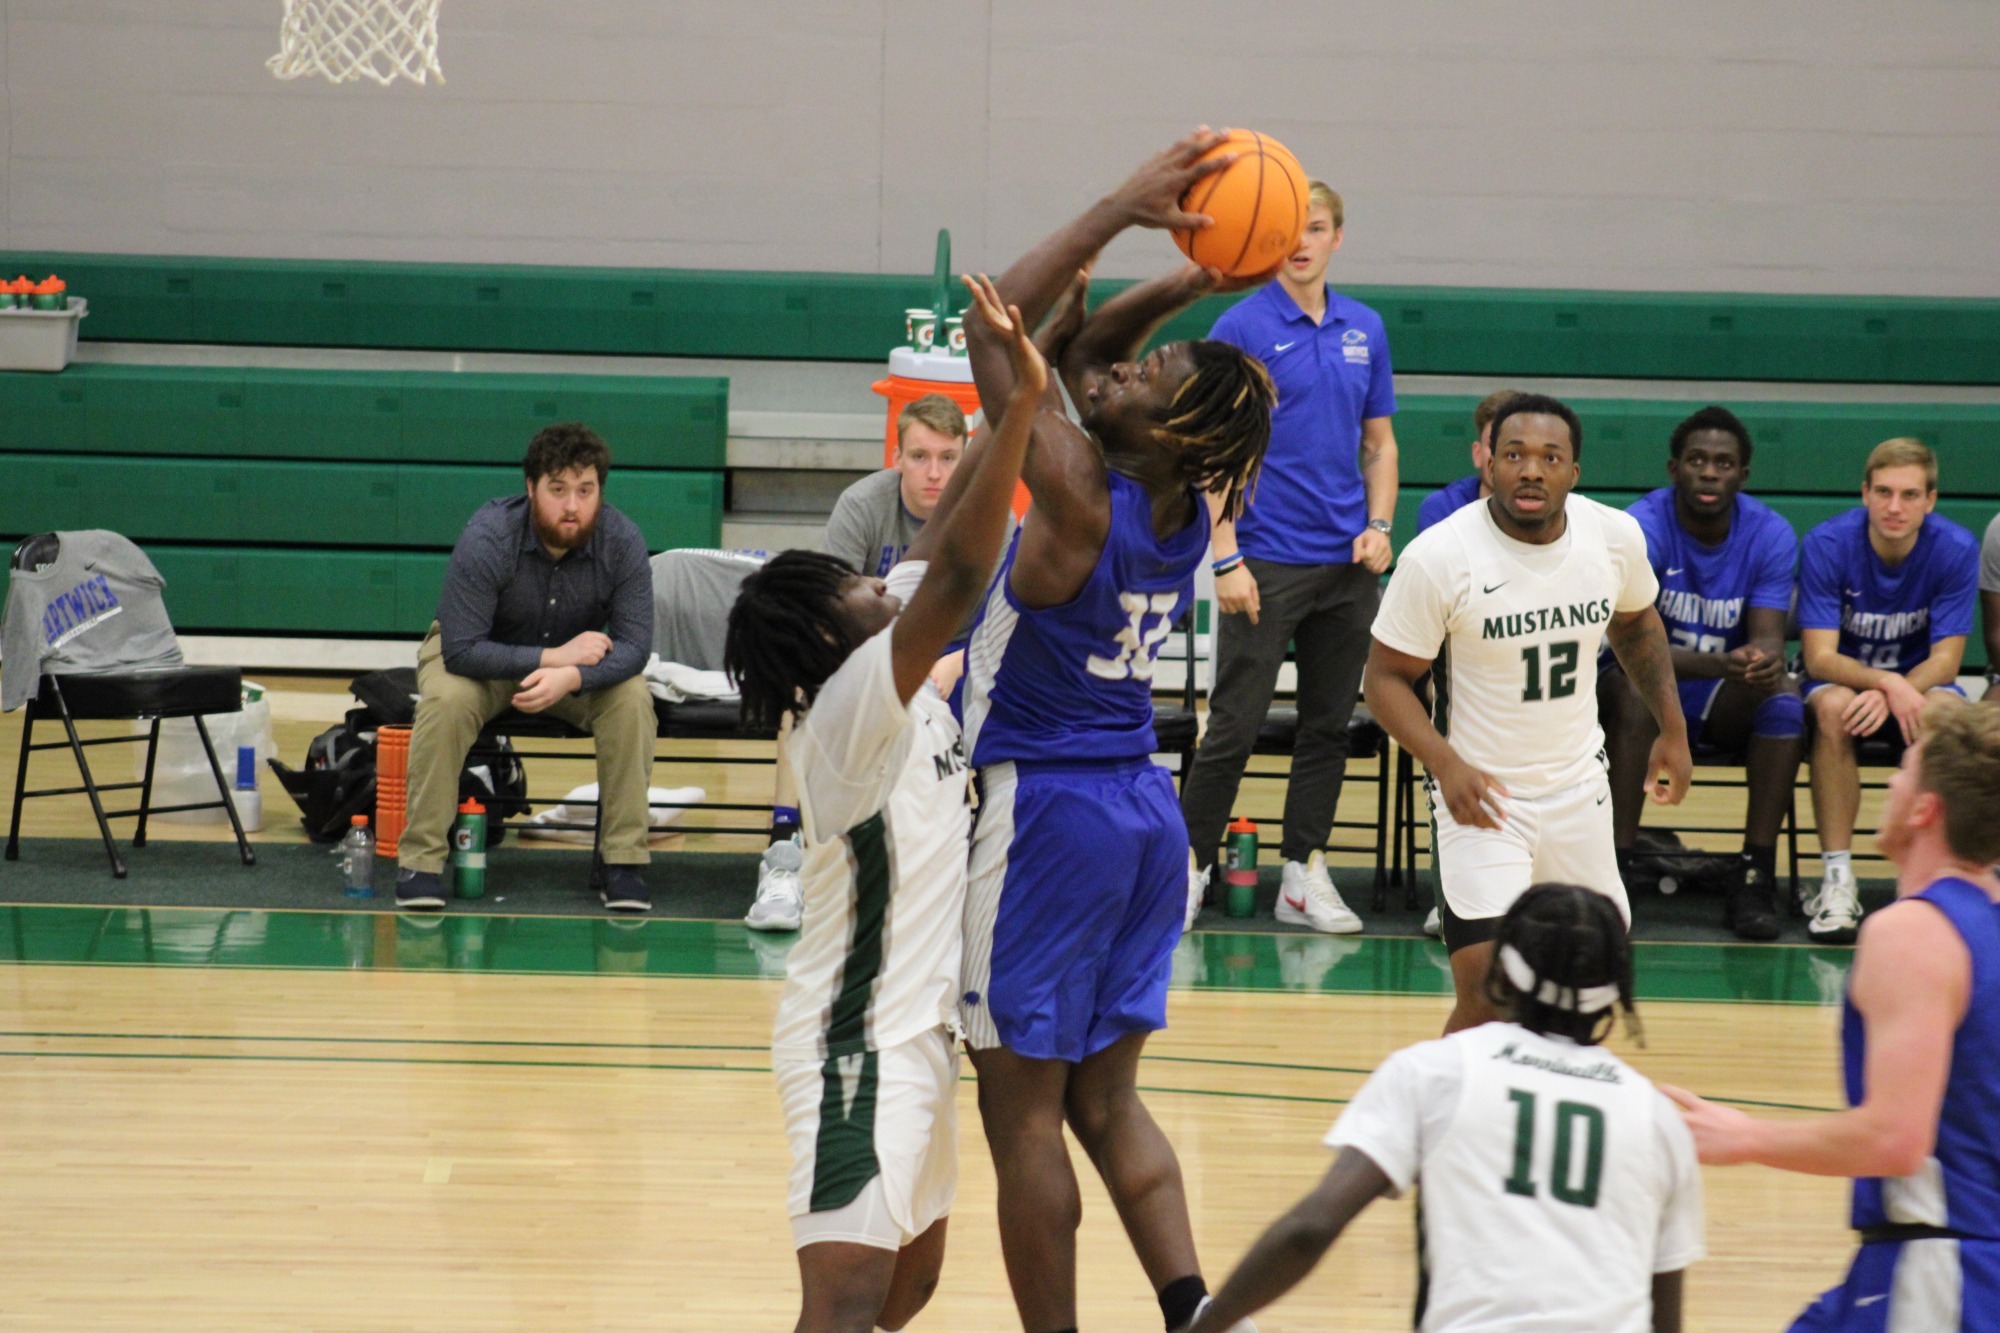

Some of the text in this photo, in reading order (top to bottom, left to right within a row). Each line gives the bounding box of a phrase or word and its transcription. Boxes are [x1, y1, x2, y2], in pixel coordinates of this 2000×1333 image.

[1482, 598, 1610, 640] MUSTANGS
[1520, 640, 1579, 703] 12
[1504, 1087, 1605, 1209] 10
